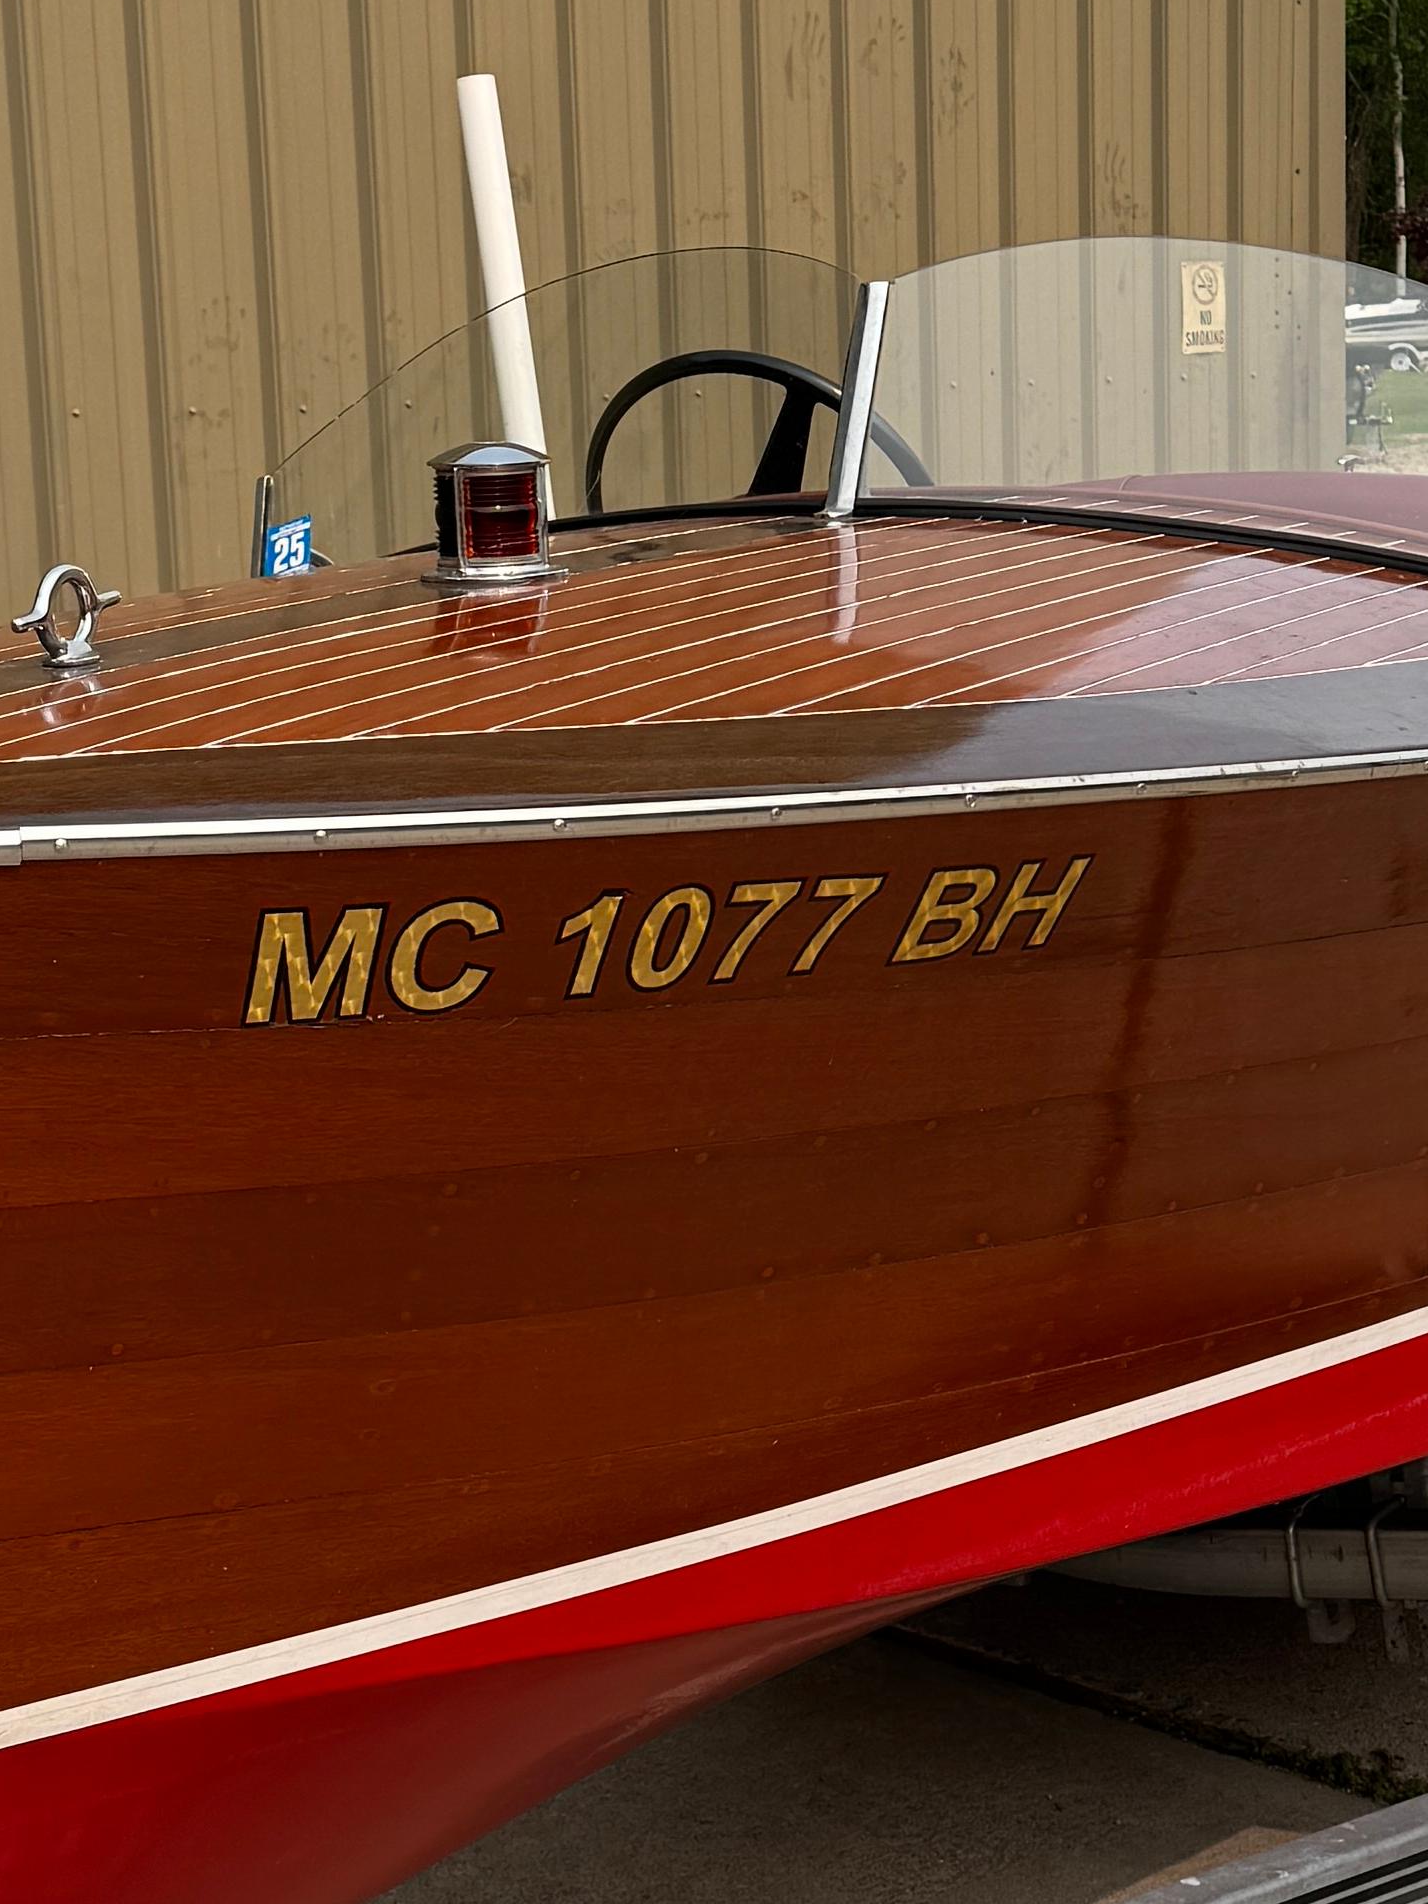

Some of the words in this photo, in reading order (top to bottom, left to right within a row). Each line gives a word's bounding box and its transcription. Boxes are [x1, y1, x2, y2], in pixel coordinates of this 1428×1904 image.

[1199, 310, 1212, 325] NO
[1185, 329, 1225, 346] SMOKING
[273, 530, 305, 575] 25
[241, 896, 504, 1028] MC
[555, 872, 889, 1000] 1077
[886, 853, 1096, 967] BH
